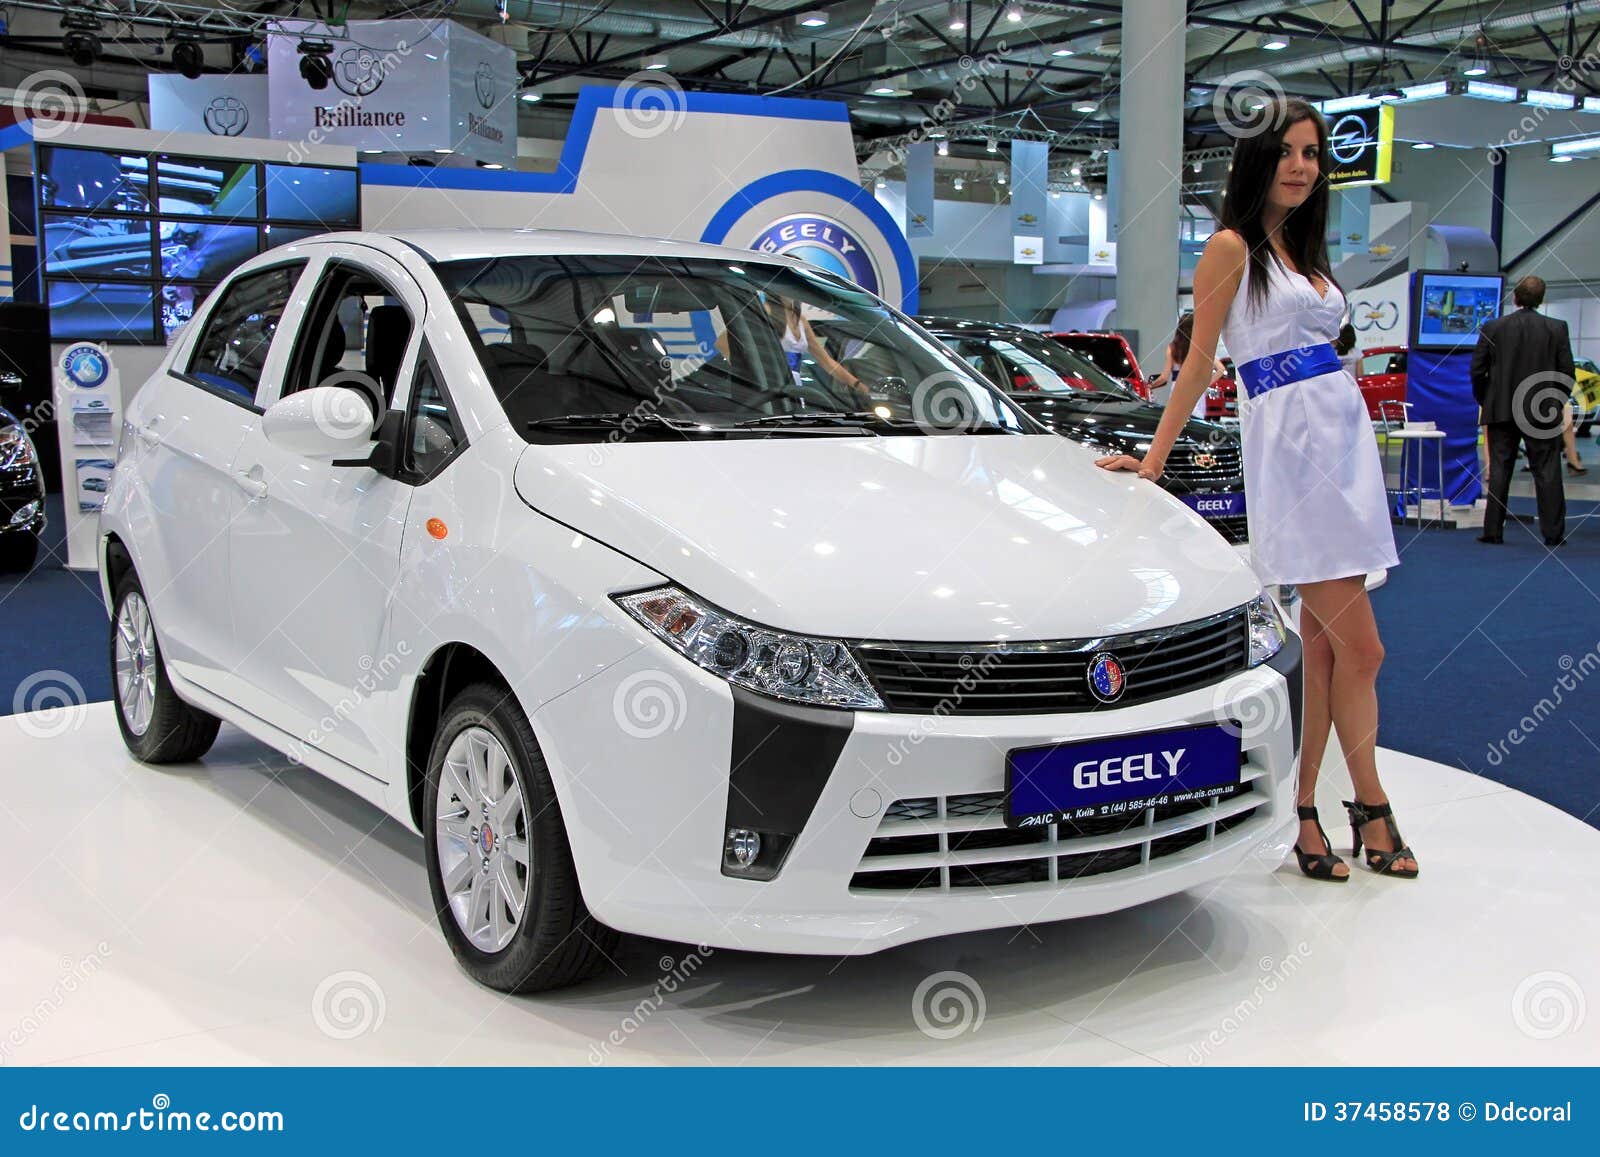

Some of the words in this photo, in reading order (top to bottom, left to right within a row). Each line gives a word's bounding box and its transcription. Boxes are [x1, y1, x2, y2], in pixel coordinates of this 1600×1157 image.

[314, 106, 405, 128] Brilliance
[759, 223, 857, 255] GEELY
[1196, 499, 1233, 511] GEELY
[1073, 748, 1186, 790] GEELY
[1110, 801, 1127, 814] (44)
[1128, 795, 1169, 811] 585-46-46
[1173, 784, 1235, 803] www.ais.com.ua
